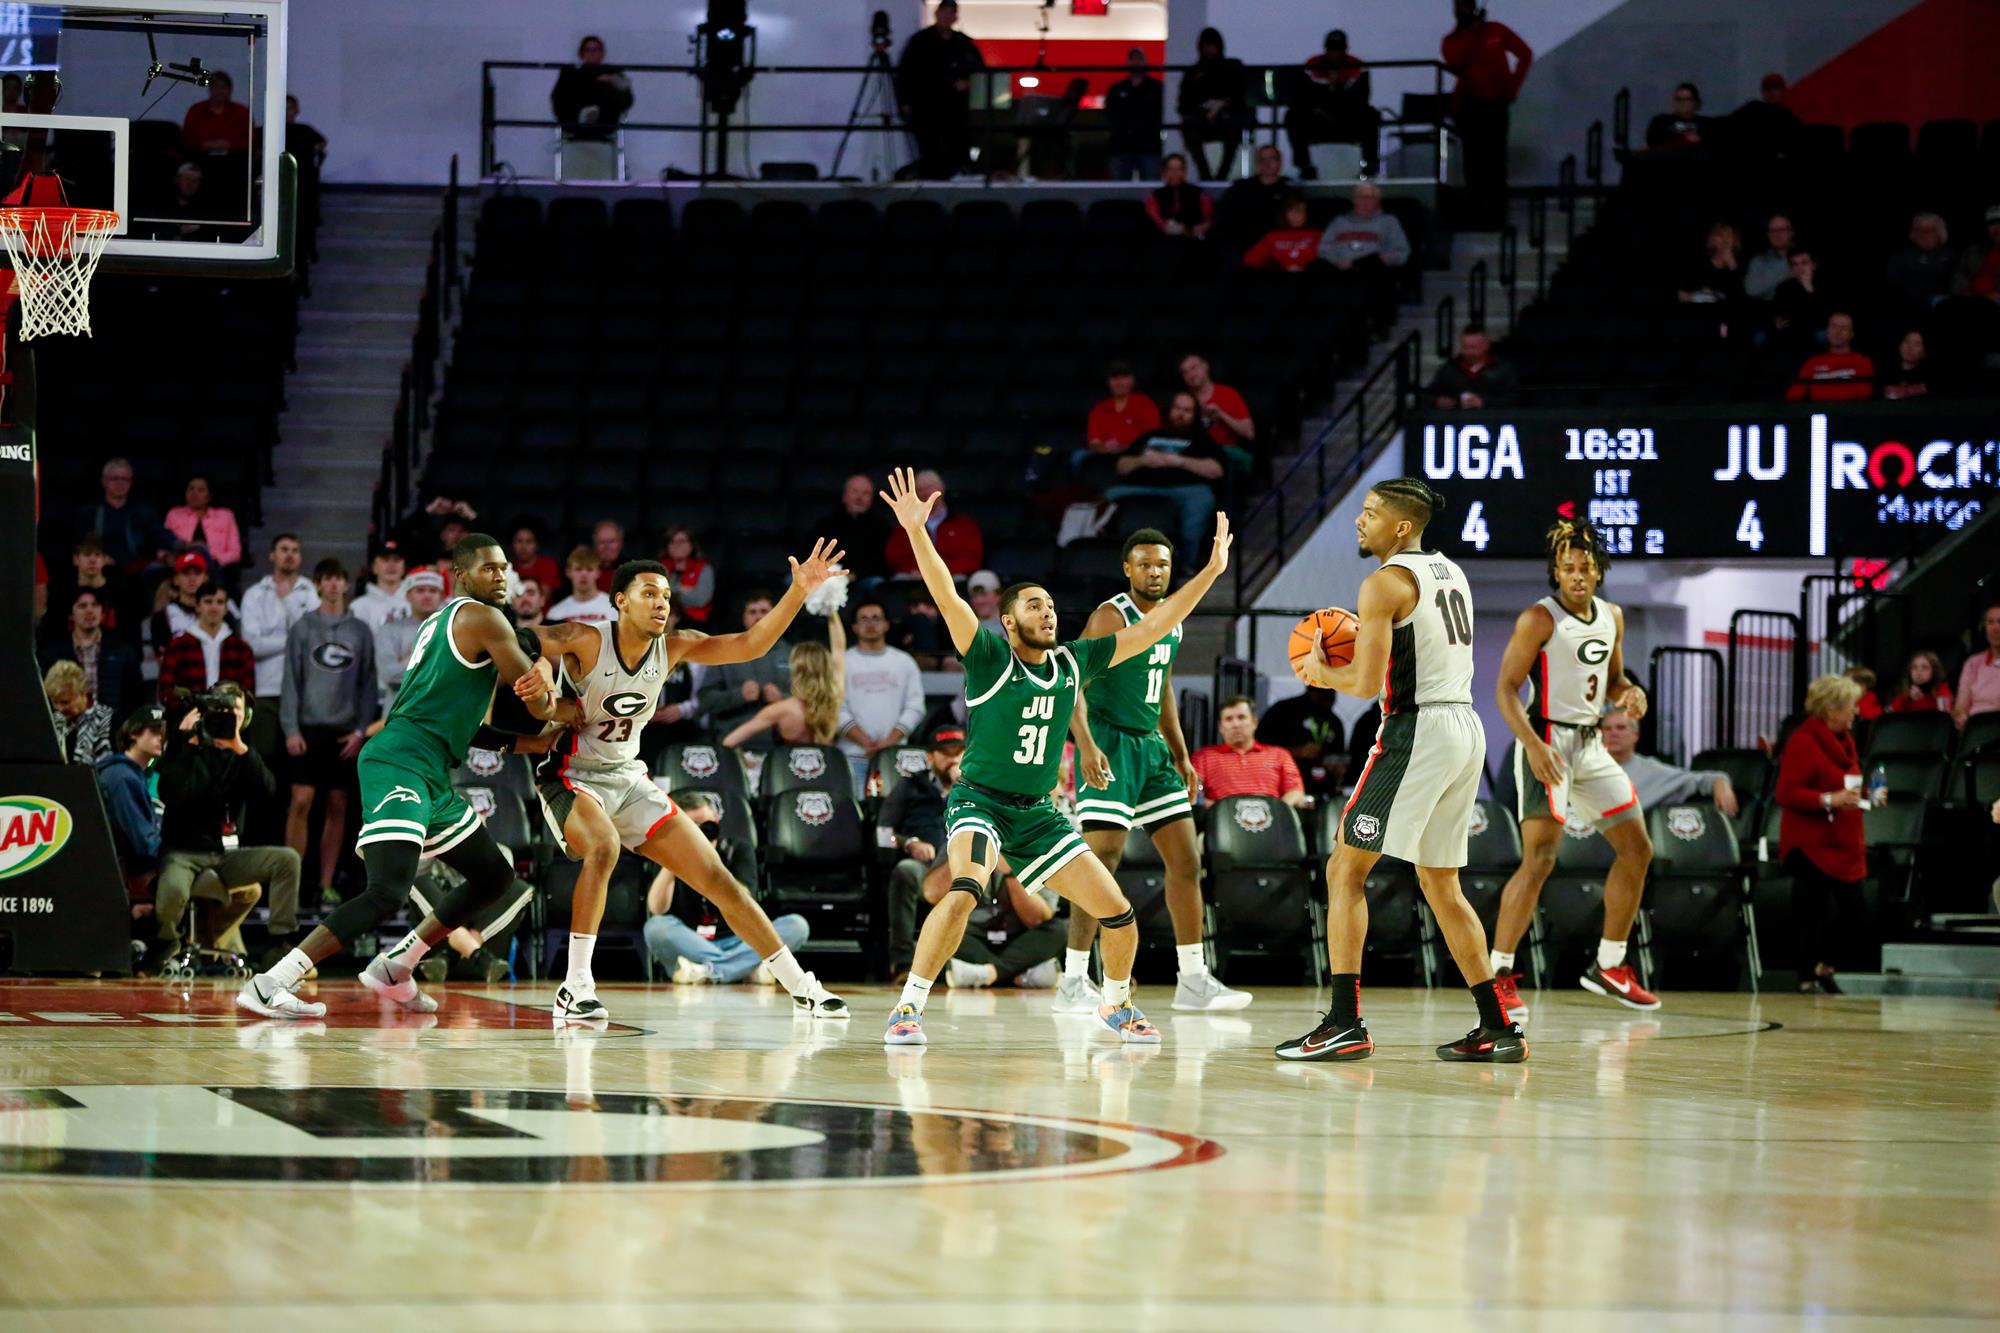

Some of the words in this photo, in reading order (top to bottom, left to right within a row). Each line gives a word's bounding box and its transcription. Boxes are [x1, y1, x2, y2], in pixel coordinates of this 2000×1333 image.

[0, 444, 31, 461] ING
[1423, 424, 1525, 480] UGA
[1565, 428, 1658, 460] 16:31
[1714, 424, 1788, 481] JU
[1831, 440, 2000, 490] ROCK
[1462, 501, 1489, 551] 4
[1589, 499, 1639, 525] POSS
[1736, 500, 1764, 551] 4
[1645, 529, 1664, 554] 2
[1435, 589, 1472, 646] 10
[312, 642, 354, 669] G
[1148, 643, 1171, 665] JU
[1577, 638, 1609, 665] G
[1144, 668, 1163, 703] 11
[1586, 673, 1598, 702] 3
[602, 692, 648, 718] G
[1022, 696, 1055, 720] JU
[597, 718, 633, 743] 23
[1013, 724, 1049, 765] 31
[22, 897, 54, 913] 1896
